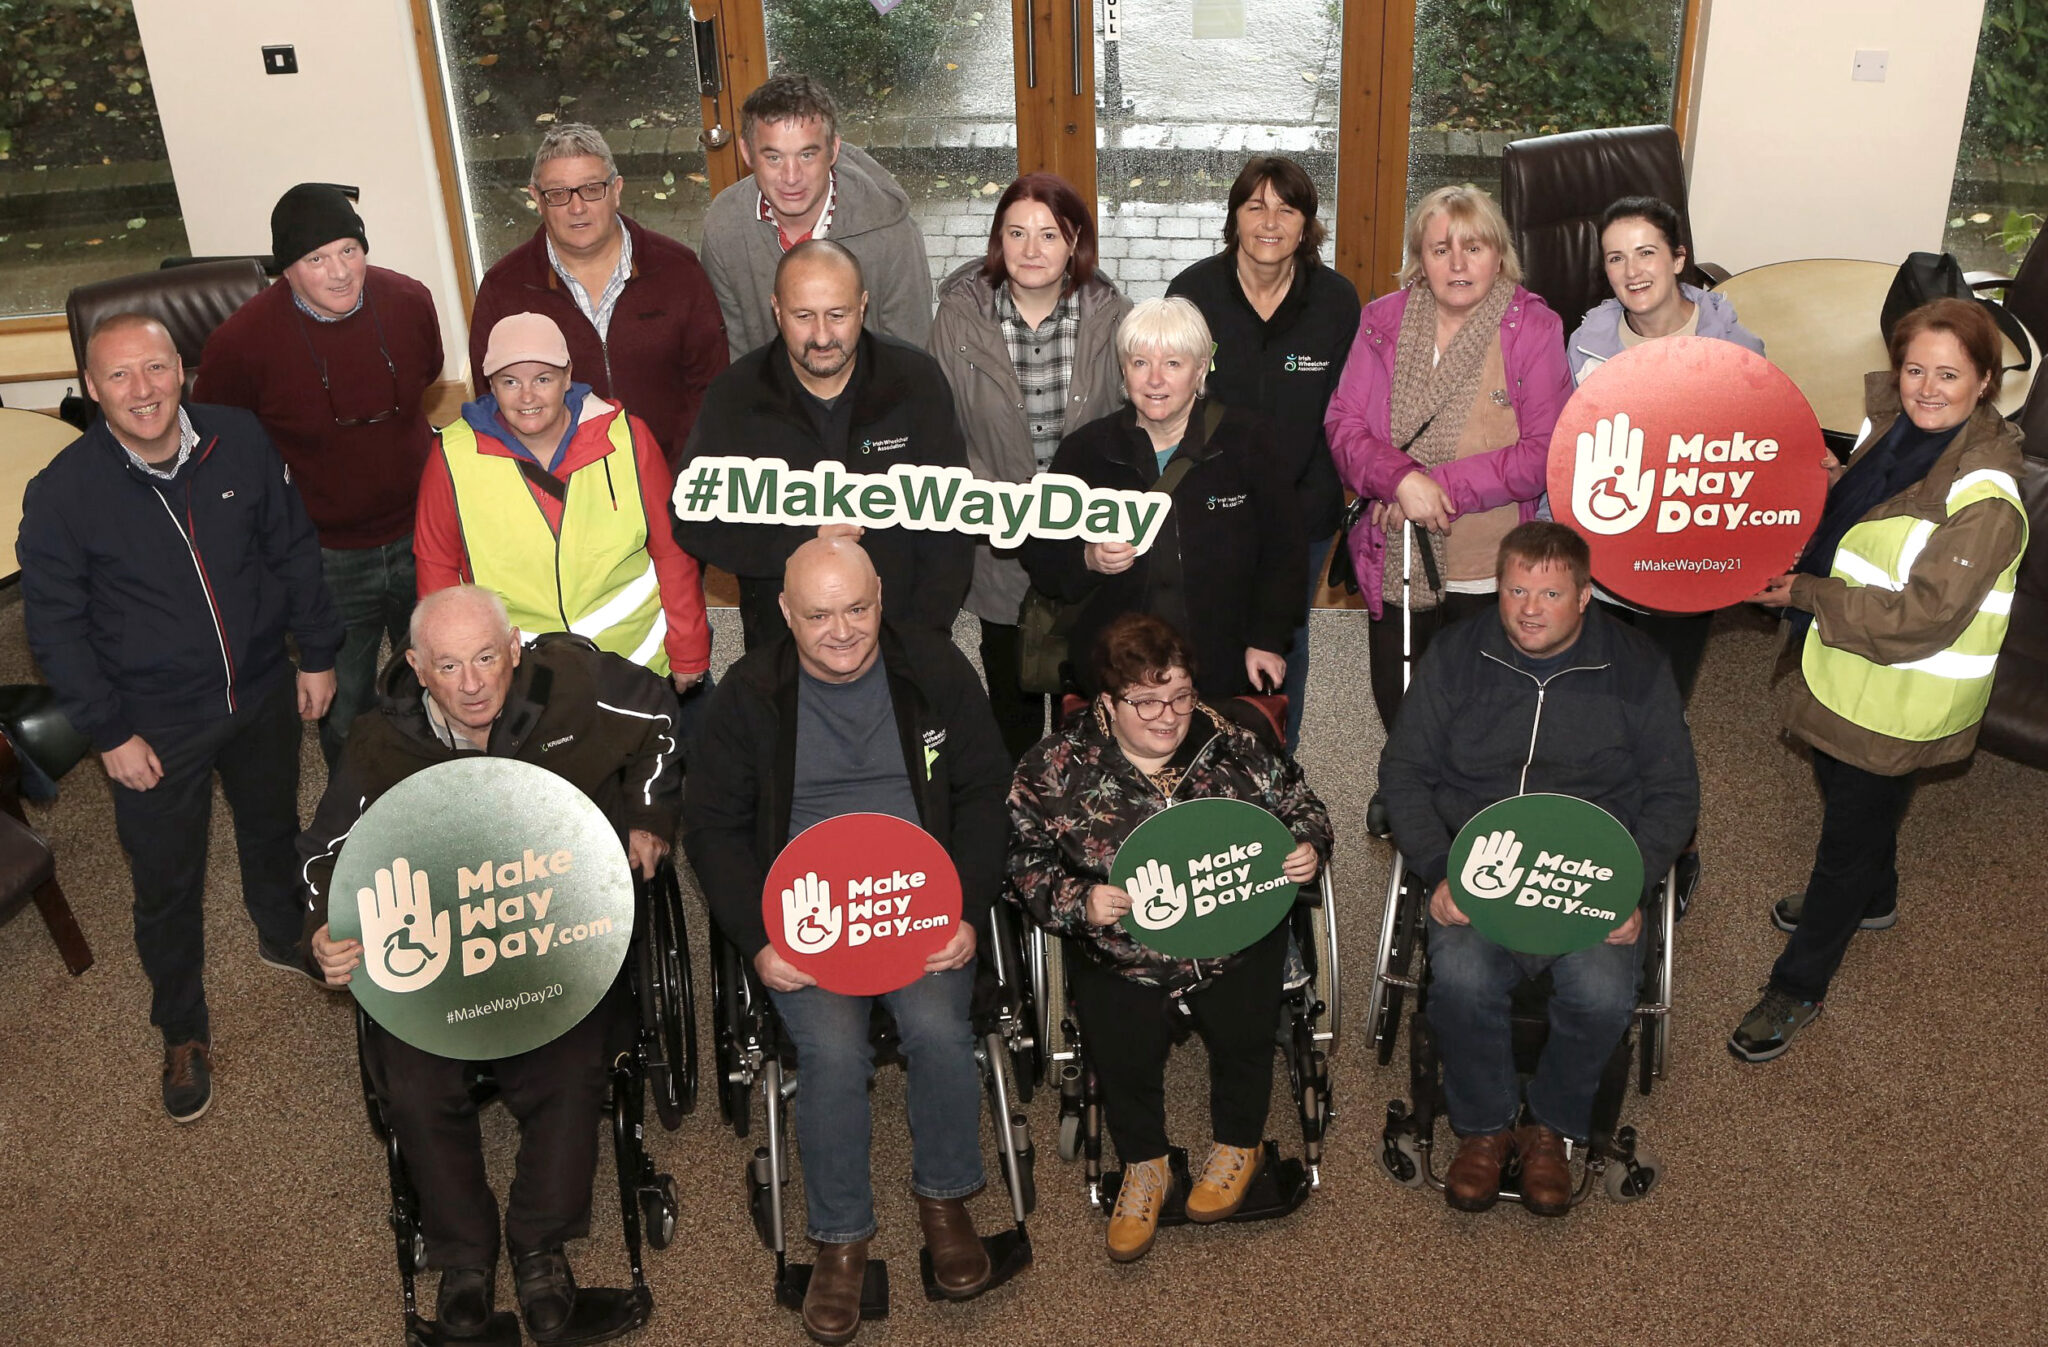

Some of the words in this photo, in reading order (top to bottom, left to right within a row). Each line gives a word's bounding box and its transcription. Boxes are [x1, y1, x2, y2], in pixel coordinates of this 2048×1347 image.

[1667, 431, 1779, 464] Make
[1662, 467, 1755, 498] Way
[685, 467, 1161, 547] #MakeWayDay
[1656, 500, 1801, 534] Day.com
[1633, 558, 1741, 573] #MakeWayDay21
[457, 848, 573, 900] Make
[1188, 842, 1263, 878] Make
[1534, 850, 1614, 881] Make
[848, 870, 926, 900] Make
[1191, 863, 1251, 897] Way
[1193, 875, 1290, 918] Day.com
[1525, 869, 1592, 897] Way
[459, 887, 554, 937] Way
[848, 894, 912, 923] Way
[1514, 886, 1616, 921] Day.com
[461, 915, 613, 977] Day.com
[848, 914, 949, 947] Day.com
[446, 983, 563, 1024] #MakeWayDay20
